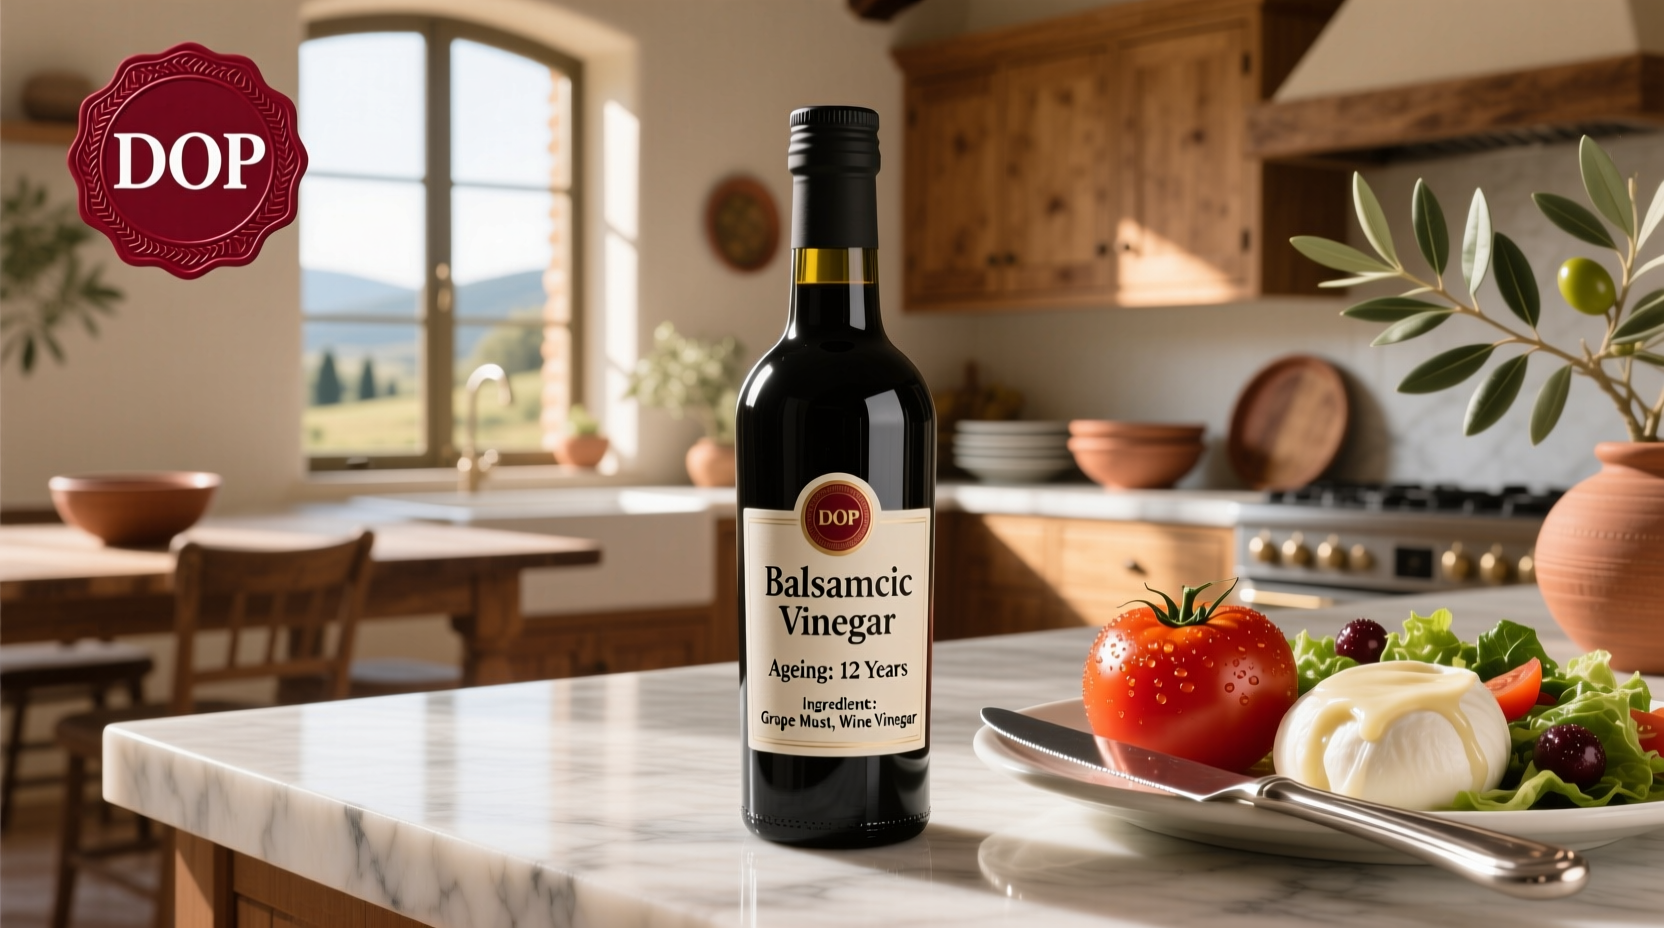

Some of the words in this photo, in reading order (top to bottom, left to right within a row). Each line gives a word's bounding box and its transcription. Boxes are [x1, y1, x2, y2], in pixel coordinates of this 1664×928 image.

[818, 509, 860, 526] DOP
[765, 565, 912, 598] Balsamcic
[778, 605, 896, 645] Vinegar
[769, 659, 834, 684] Ageing:
[840, 661, 860, 679] 12
[864, 660, 908, 679] Years
[839, 714, 872, 728] Wine
[874, 712, 917, 728] Vinegar
